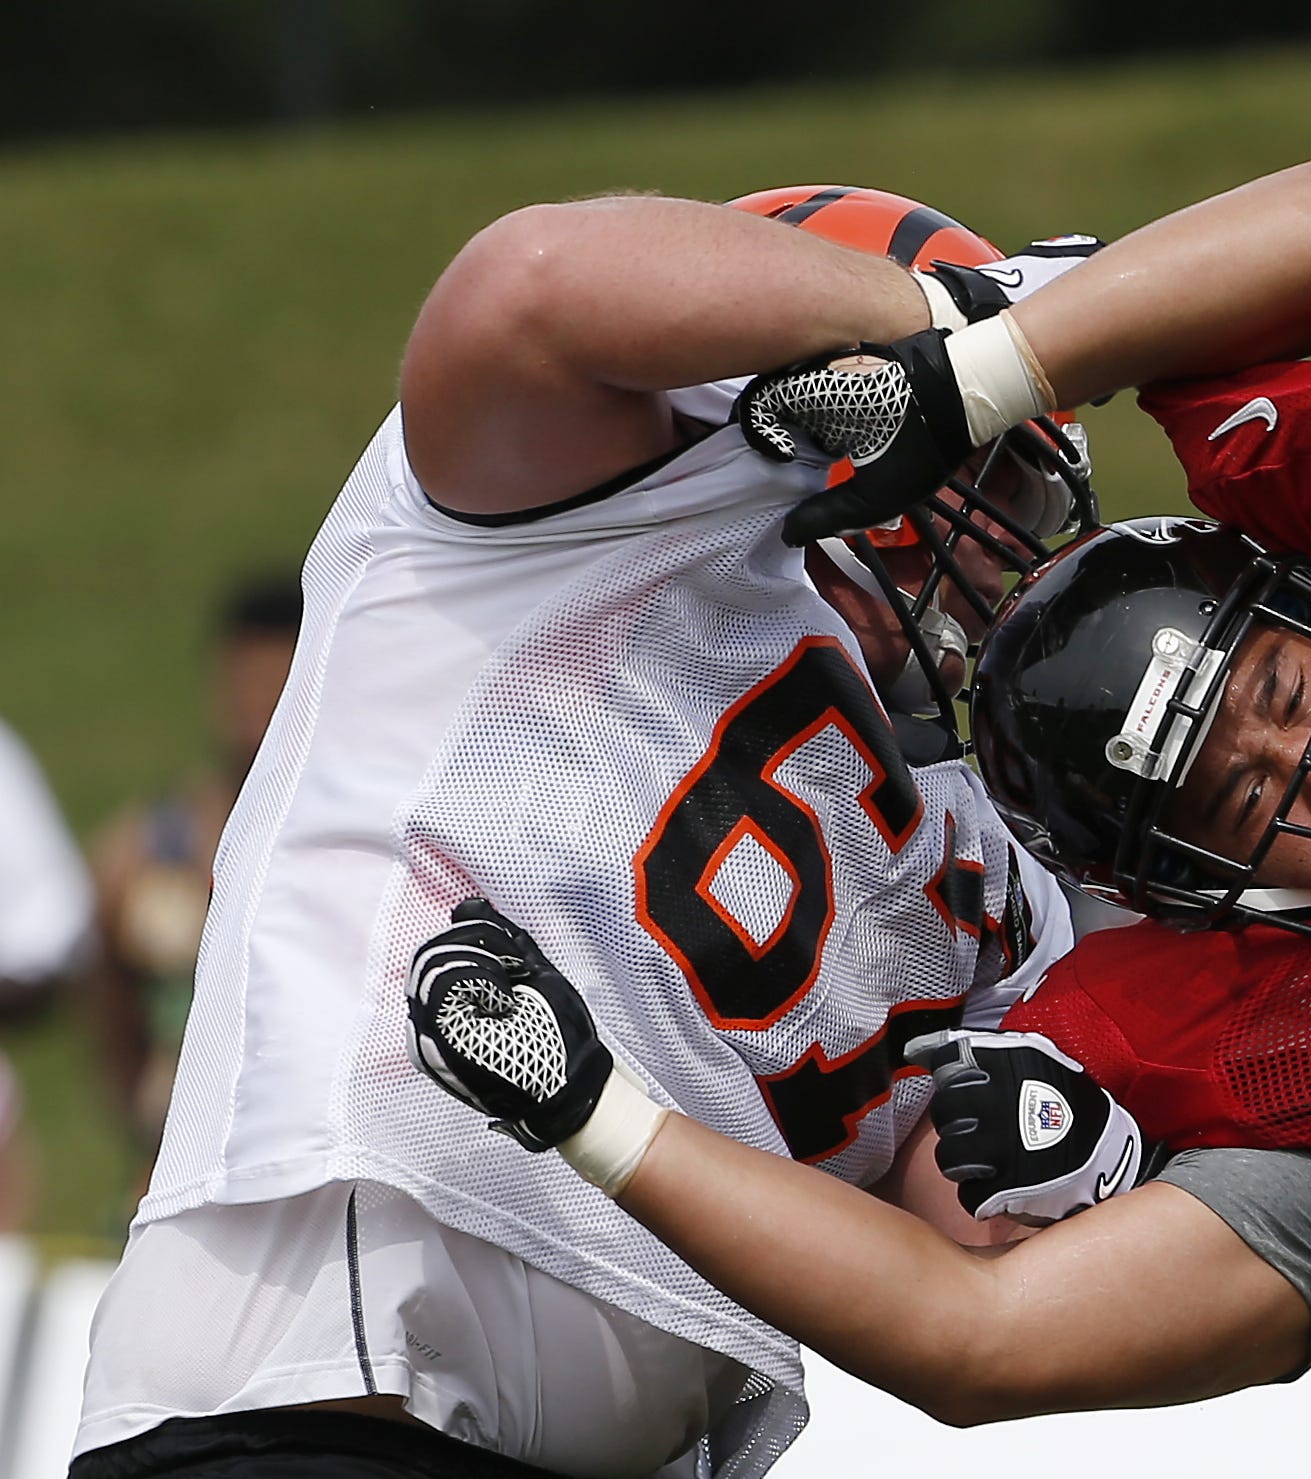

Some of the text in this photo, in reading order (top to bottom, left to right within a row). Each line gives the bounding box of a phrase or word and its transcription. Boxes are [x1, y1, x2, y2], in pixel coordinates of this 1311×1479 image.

[1137, 669, 1172, 733] FALCONS
[1027, 1089, 1039, 1142] EQUIPMENT
[1050, 1103, 1063, 1127] NFL
